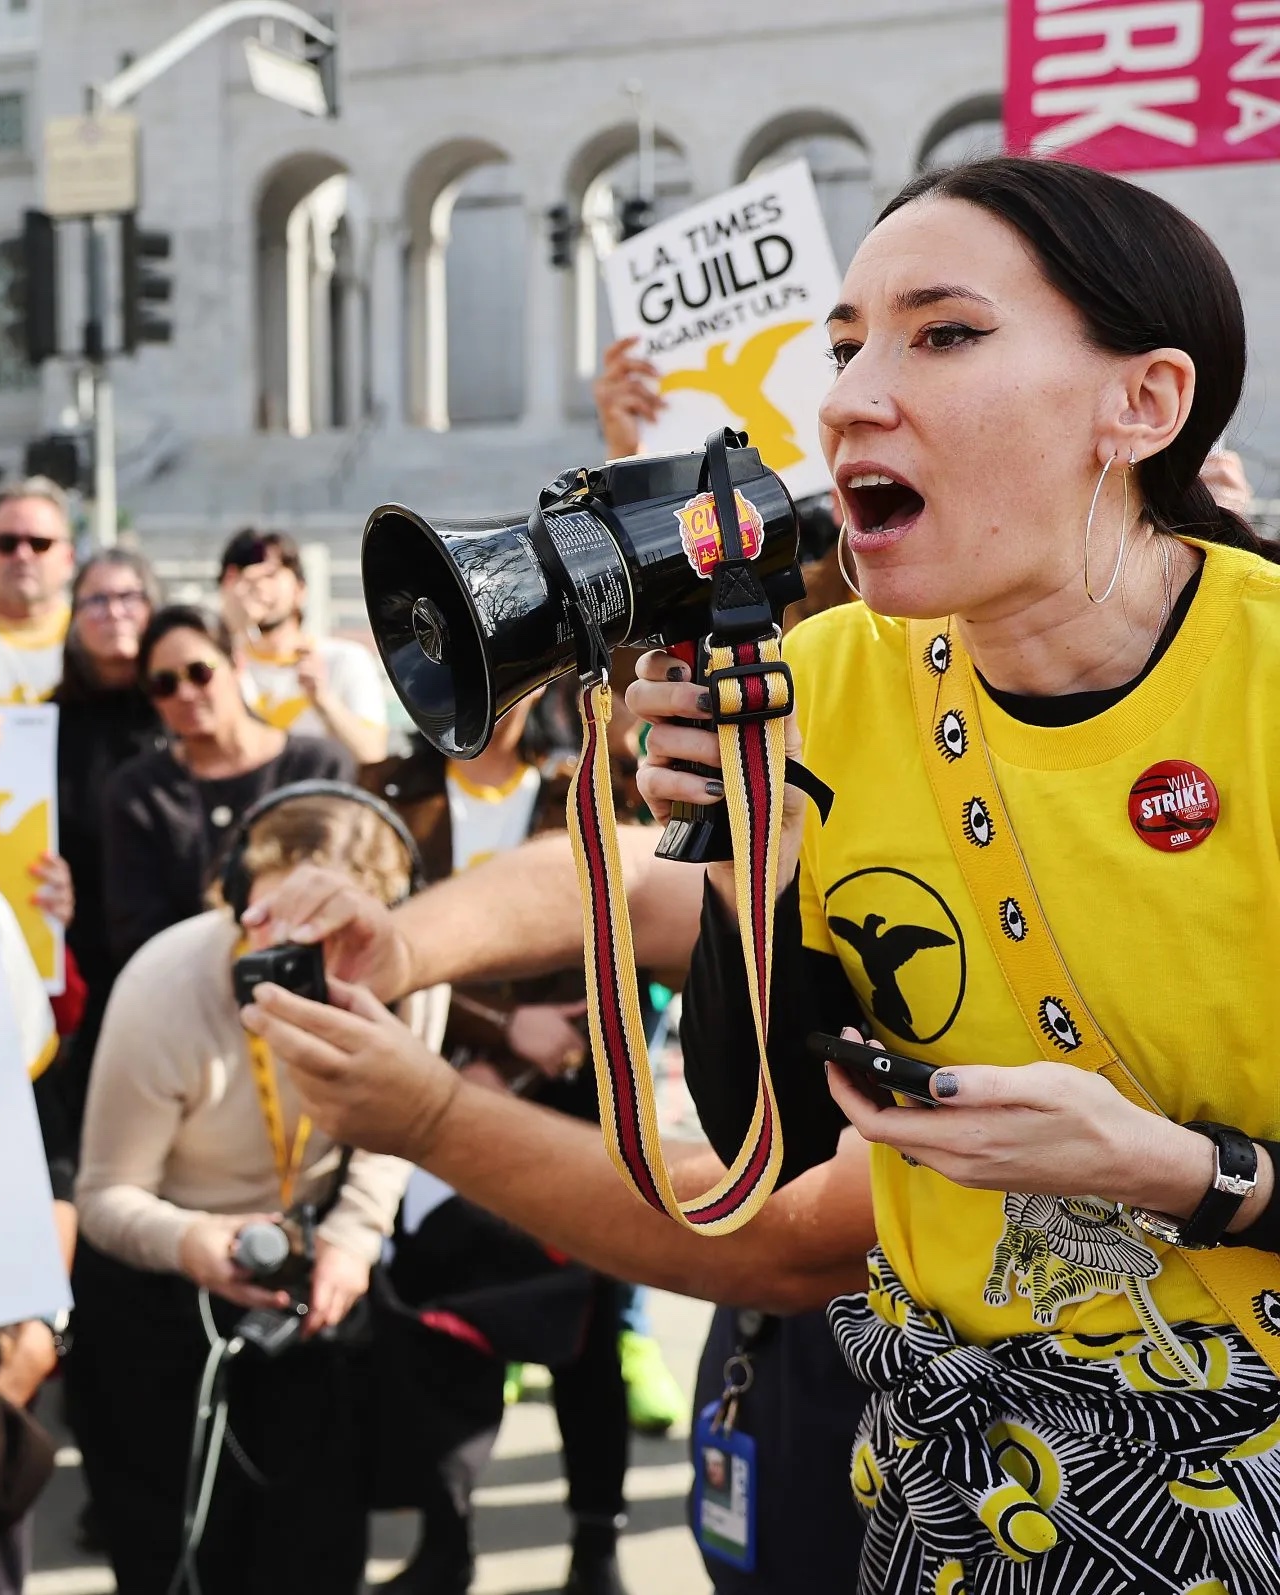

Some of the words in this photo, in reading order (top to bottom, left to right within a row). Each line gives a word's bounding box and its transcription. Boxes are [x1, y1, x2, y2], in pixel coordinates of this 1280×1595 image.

[1030, 0, 1205, 157] RK
[685, 194, 783, 254] TIMES
[639, 234, 794, 325] GUILD
[647, 302, 745, 355] AGAINST
[690, 504, 741, 535] CW
[1141, 782, 1209, 819] STRIKE
[1166, 771, 1202, 792] WILL
[1169, 831, 1191, 844] CWA
